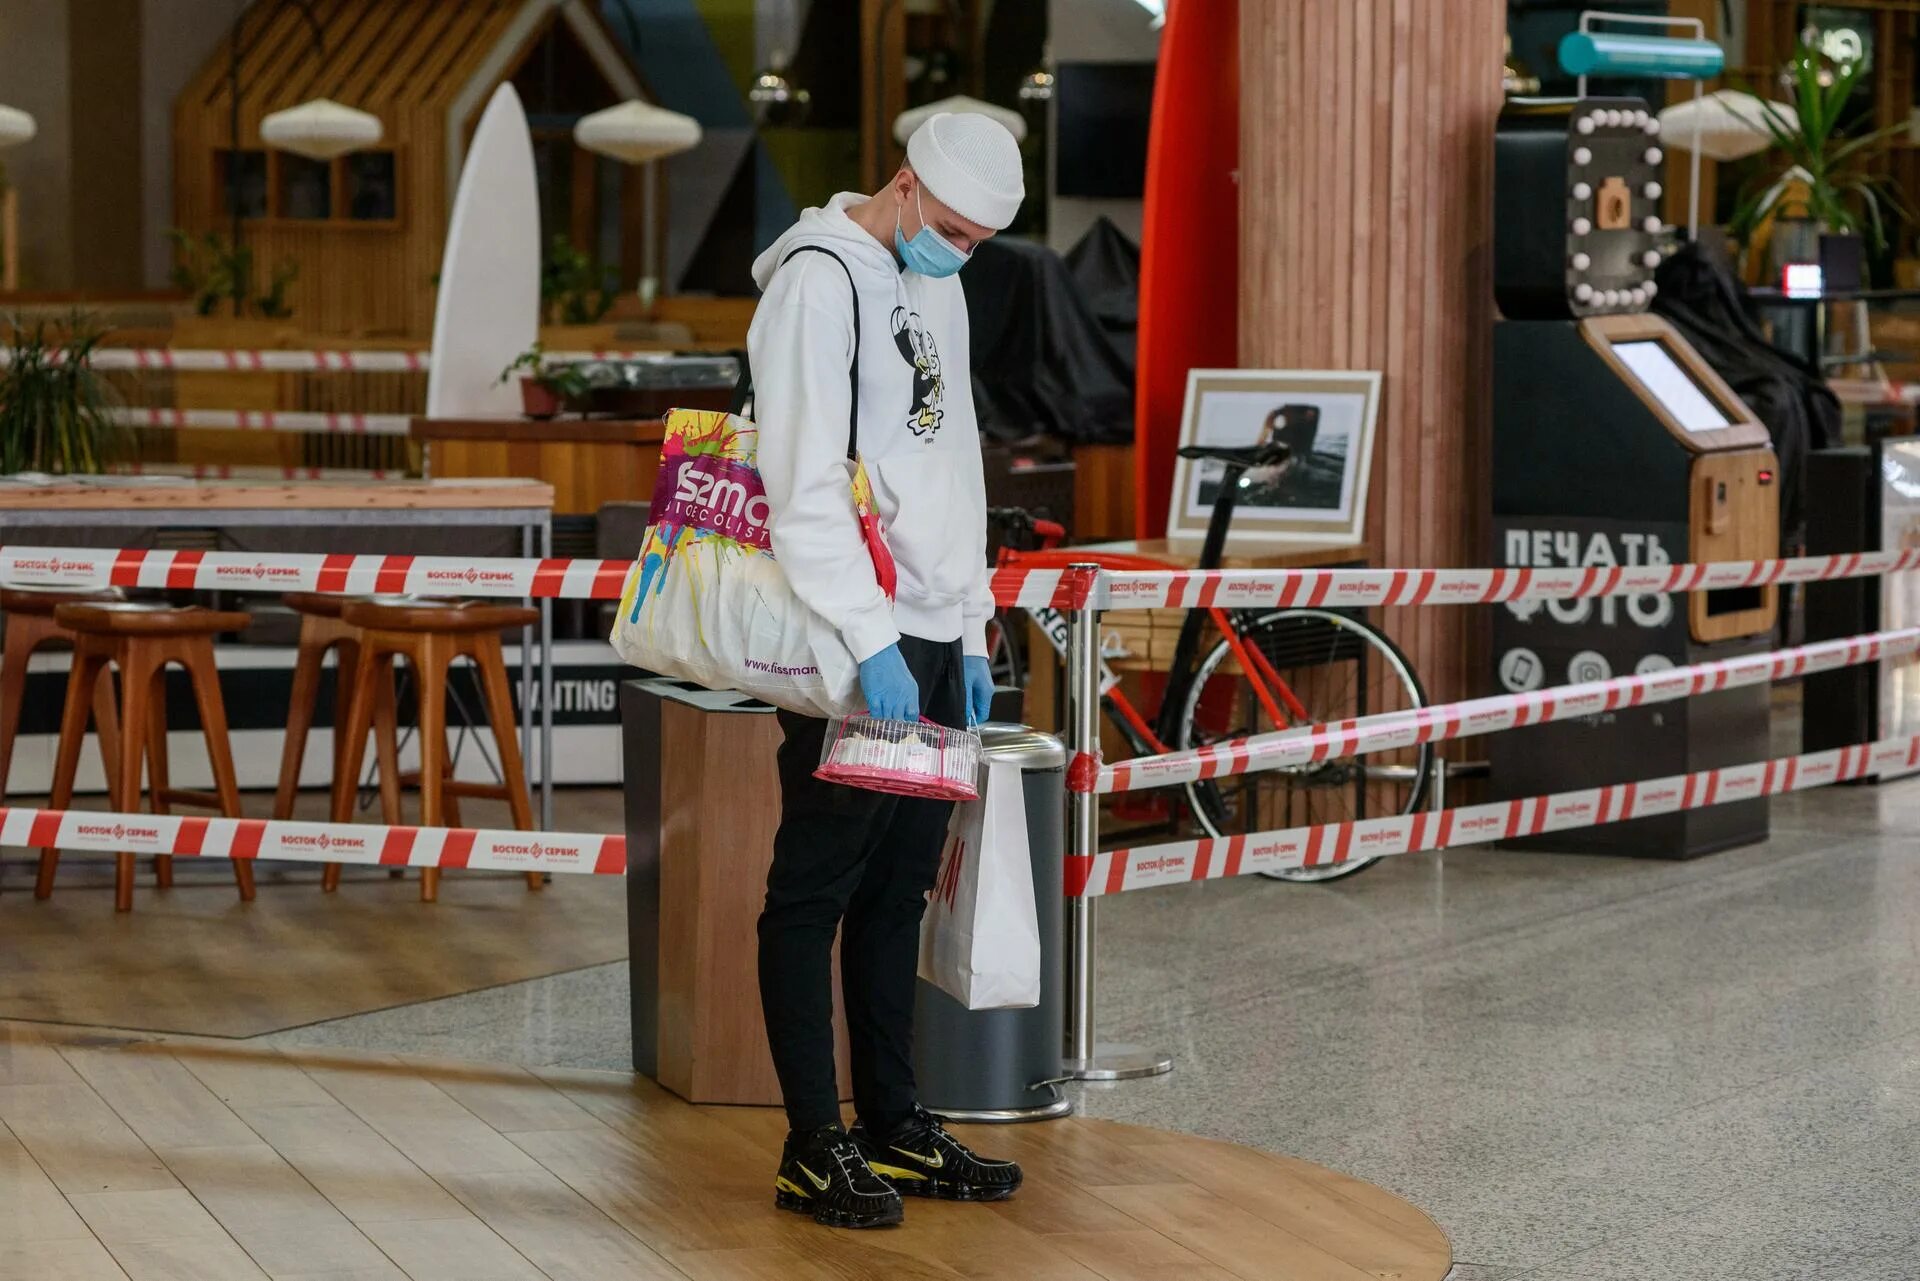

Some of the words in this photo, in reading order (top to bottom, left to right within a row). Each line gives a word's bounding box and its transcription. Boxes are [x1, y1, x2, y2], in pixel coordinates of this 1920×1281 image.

[1505, 528, 1670, 567] ПЕЧАТЬ
[13, 559, 48, 569] ВОСТОК
[62, 562, 95, 572] СЕРВИС
[216, 566, 252, 575] ВОСТОК
[267, 568, 300, 577] СЕРВИС
[427, 571, 464, 580] ВОСТОК
[480, 572, 514, 581] СЕРВИС
[516, 680, 616, 711] WITING
[77, 825, 112, 835] ВОСТОК
[126, 828, 159, 838] СЕРВИС
[281, 835, 316, 846] ВОСТОК
[332, 837, 365, 848] СЕРВИС
[492, 844, 528, 854] ВОСТОК
[545, 846, 579, 857] СЕРВИС
